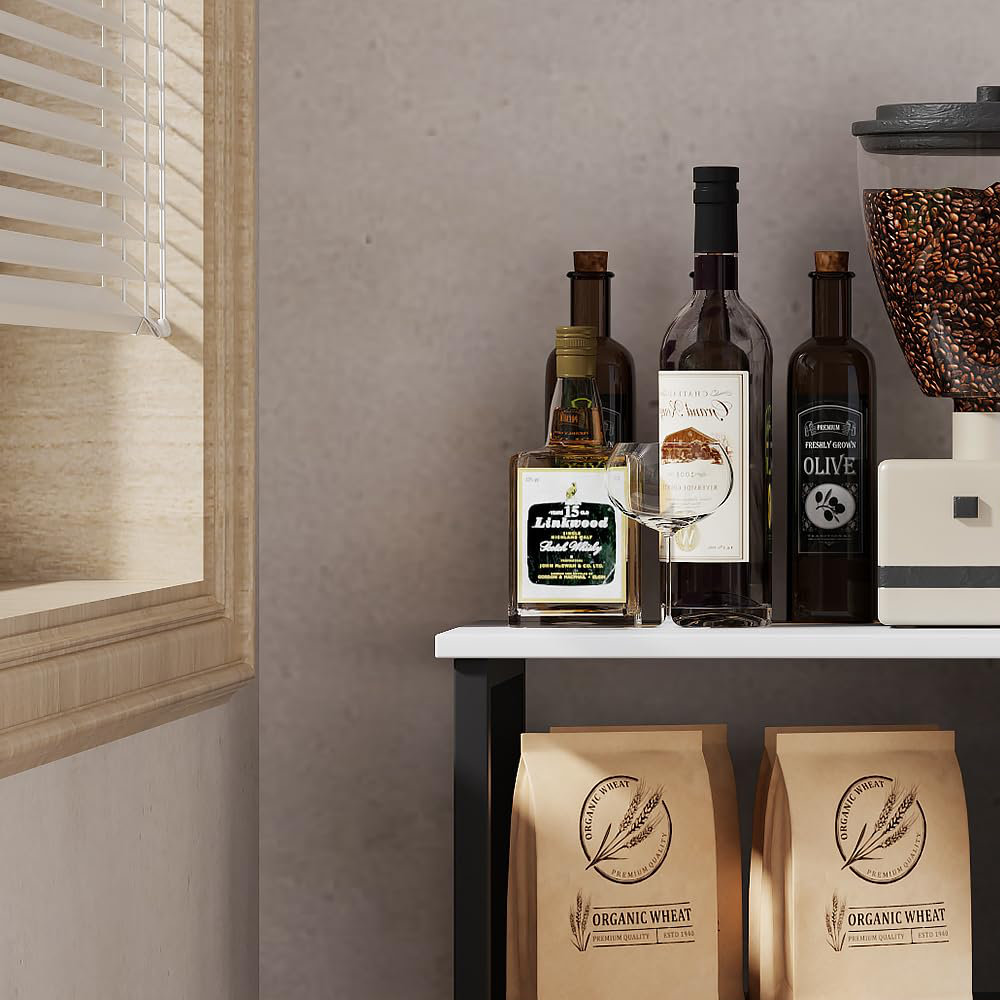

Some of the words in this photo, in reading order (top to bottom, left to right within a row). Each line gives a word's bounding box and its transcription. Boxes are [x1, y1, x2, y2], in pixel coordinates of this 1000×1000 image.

[805, 440, 832, 449] FRESHLY
[832, 440, 857, 449] GROWN
[803, 453, 856, 475] OLIVE
[564, 505, 580, 517] 15
[531, 516, 609, 529] Linkwood
[540, 540, 569, 552] Scotch
[585, 793, 601, 840] ORGANIC
[599, 780, 630, 795] WHEAT
[841, 793, 857, 840] ORGANIC
[854, 780, 885, 795] WHEAT
[611, 866, 649, 879] PREMIUM
[648, 832, 668, 868] QUALITY
[866, 866, 904, 879] PREMIUM
[903, 832, 922, 868] QUALITY
[592, 911, 648, 926] ORGANIC
[649, 908, 692, 923] WHEAT
[848, 911, 902, 926] ORGANIC
[905, 908, 945, 923] WHEAT
[623, 933, 649, 942] QUALITY
[879, 933, 905, 942] QUALITY
